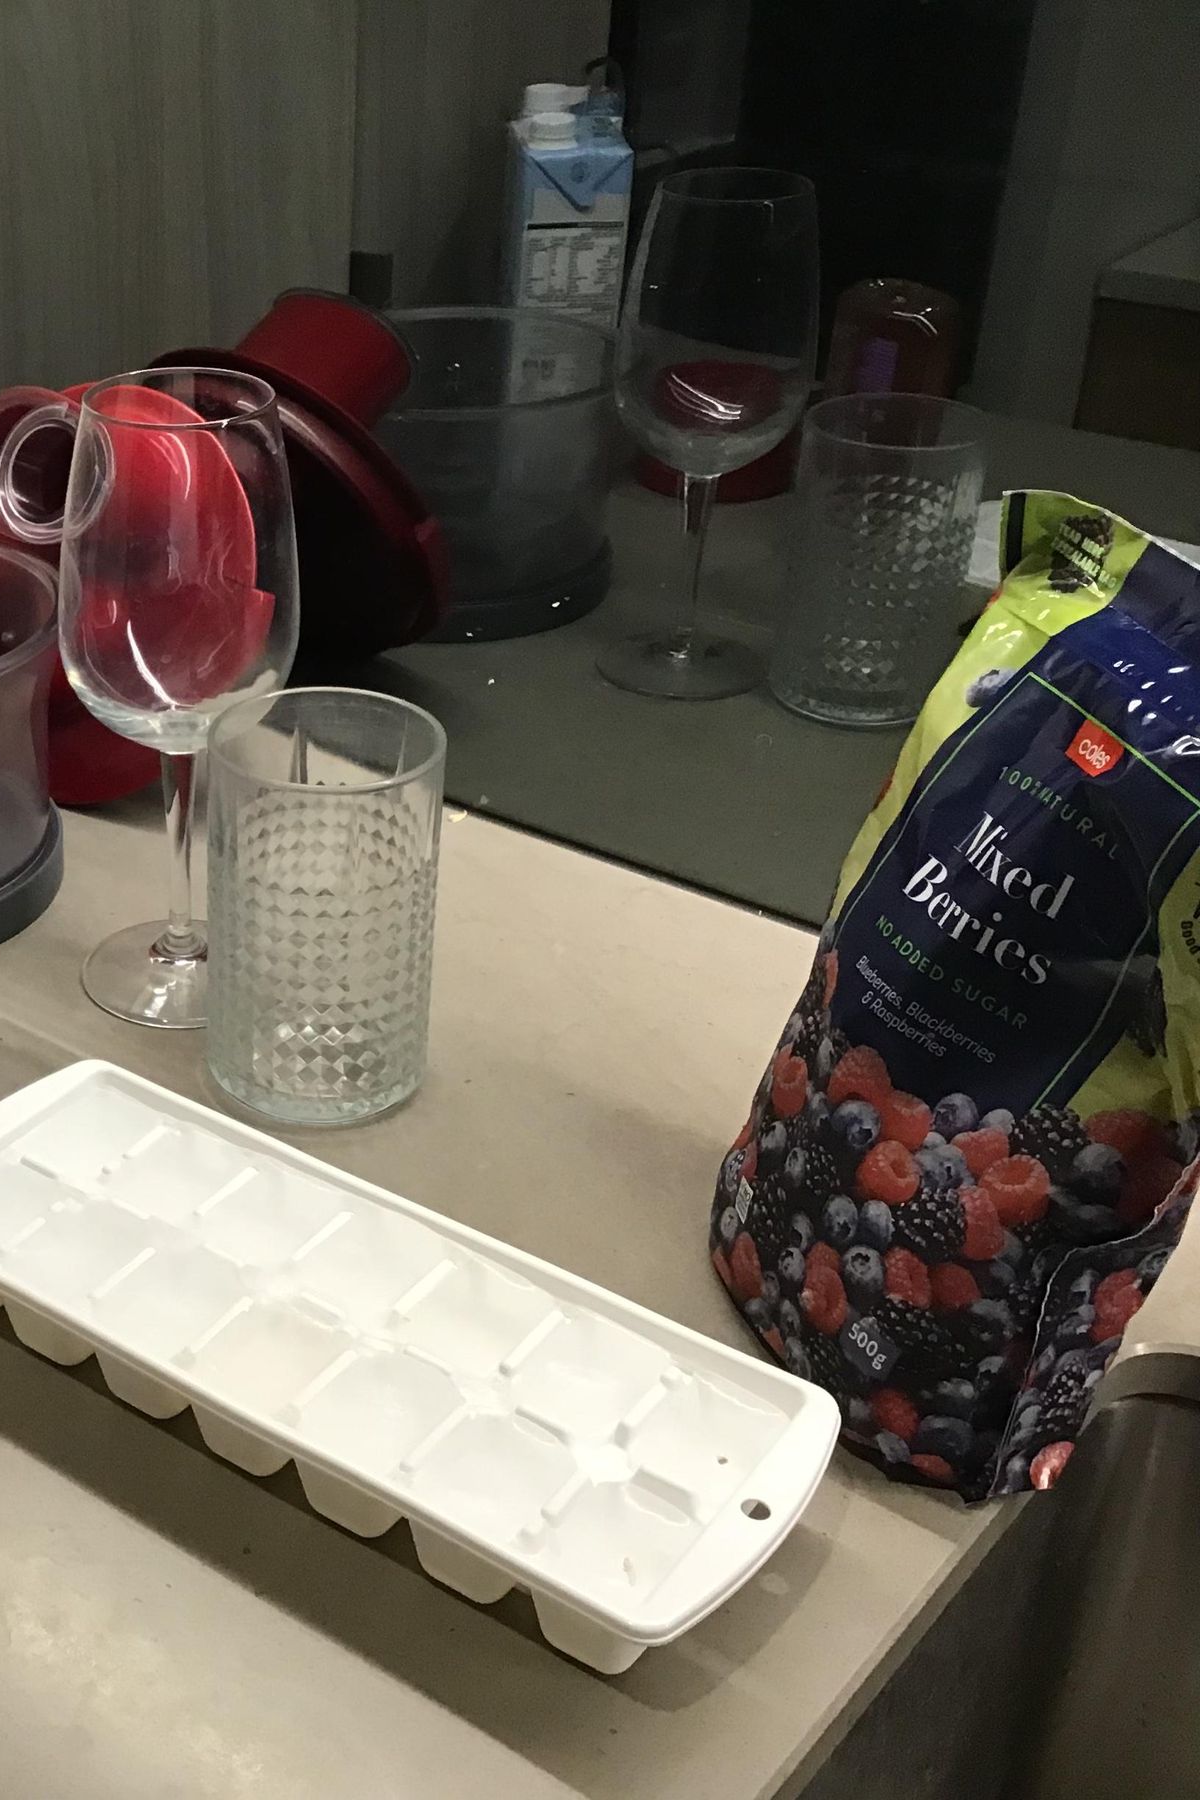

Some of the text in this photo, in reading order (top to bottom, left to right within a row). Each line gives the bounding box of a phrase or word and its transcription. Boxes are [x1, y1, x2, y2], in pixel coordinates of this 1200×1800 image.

[1078, 739, 1111, 769] coles
[953, 811, 1075, 919] Mixed
[901, 853, 1051, 985] Berries
[875, 915, 1028, 1030] NO ADDED SUGAR
[862, 991, 947, 1057] & Raspberries
[905, 1001, 996, 1063] Blackberries
[848, 1323, 887, 1370] 500g
